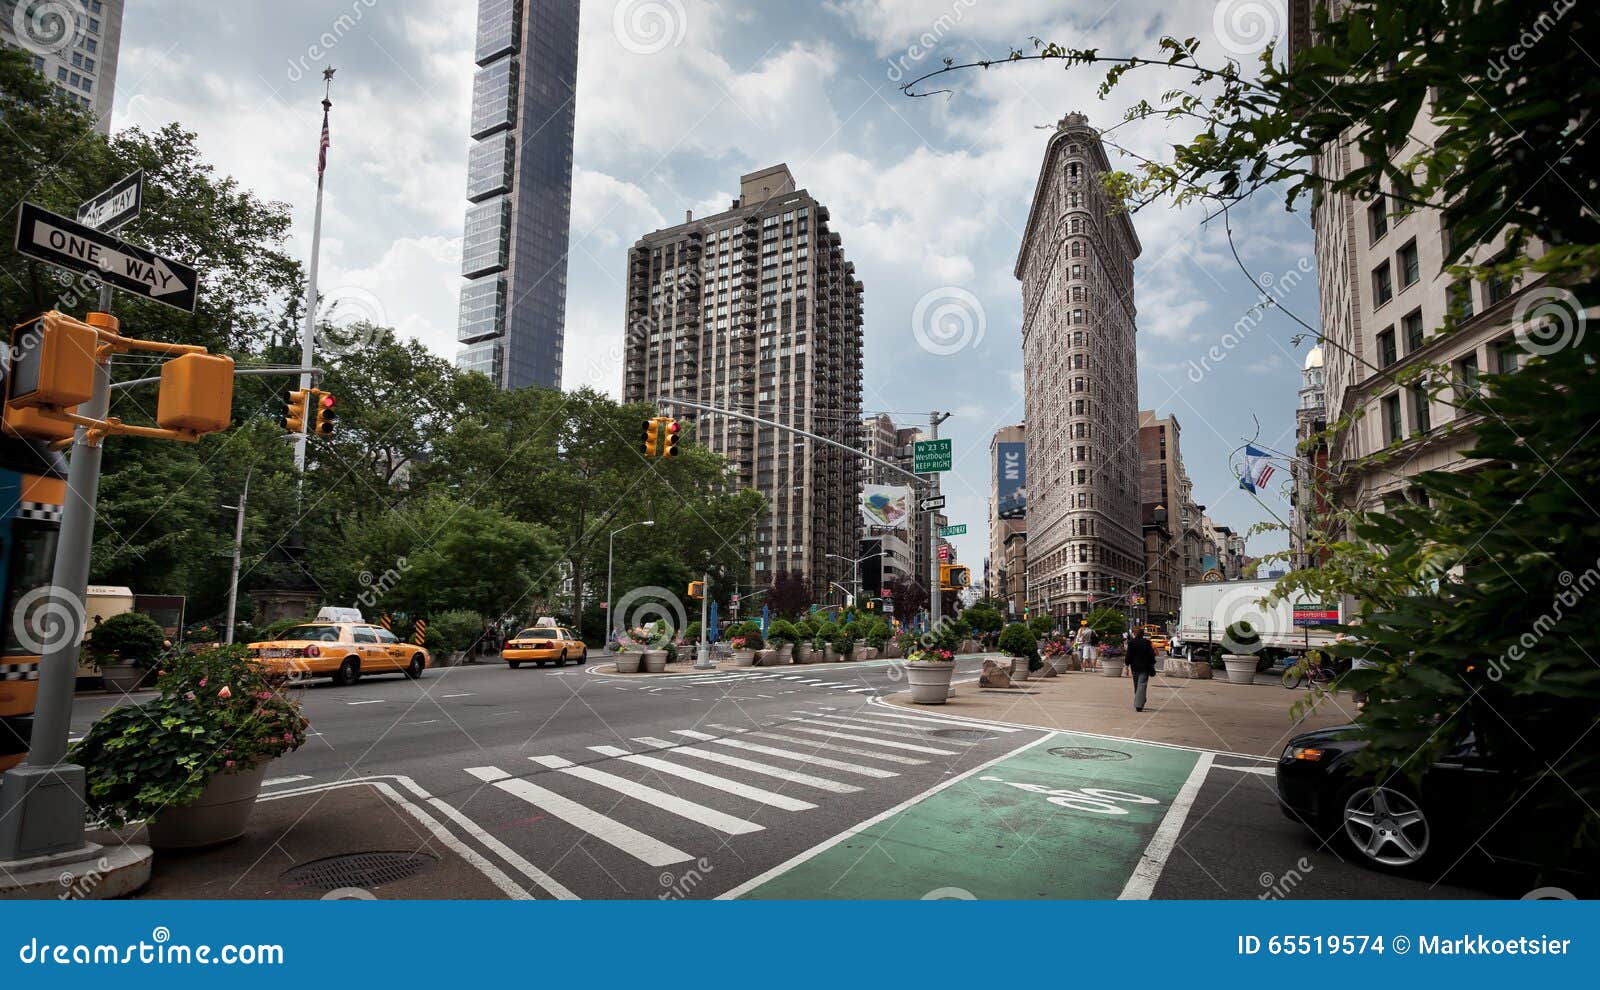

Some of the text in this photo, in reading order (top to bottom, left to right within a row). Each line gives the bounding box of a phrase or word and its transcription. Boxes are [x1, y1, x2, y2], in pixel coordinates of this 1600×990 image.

[112, 189, 133, 215] WAY
[50, 230, 173, 289] ONE WAY
[916, 451, 951, 461] Westbound
[916, 460, 950, 470] KEEP RIGHT
[1005, 452, 1019, 480] NYC
